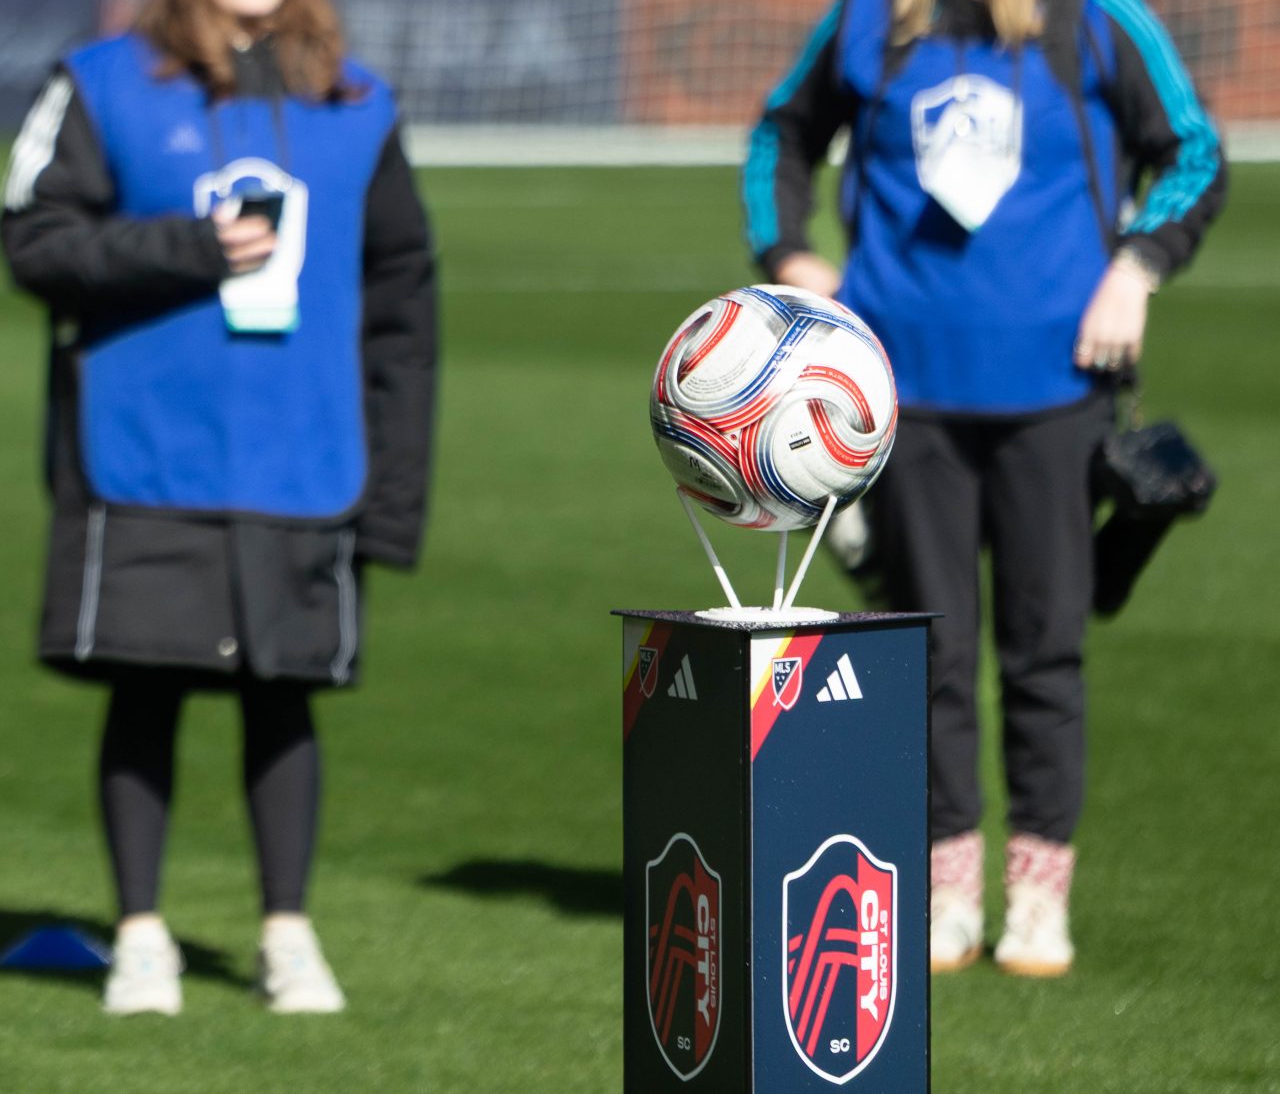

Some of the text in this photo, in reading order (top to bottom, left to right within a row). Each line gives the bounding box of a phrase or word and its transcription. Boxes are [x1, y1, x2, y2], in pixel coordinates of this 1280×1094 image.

[774, 662, 791, 674] MLS
[697, 894, 710, 1027] CITY
[860, 889, 879, 1022] CITY
[879, 910, 888, 1001] ST LOUIS
[677, 1035, 691, 1051] SC
[830, 1038, 850, 1054] SC
